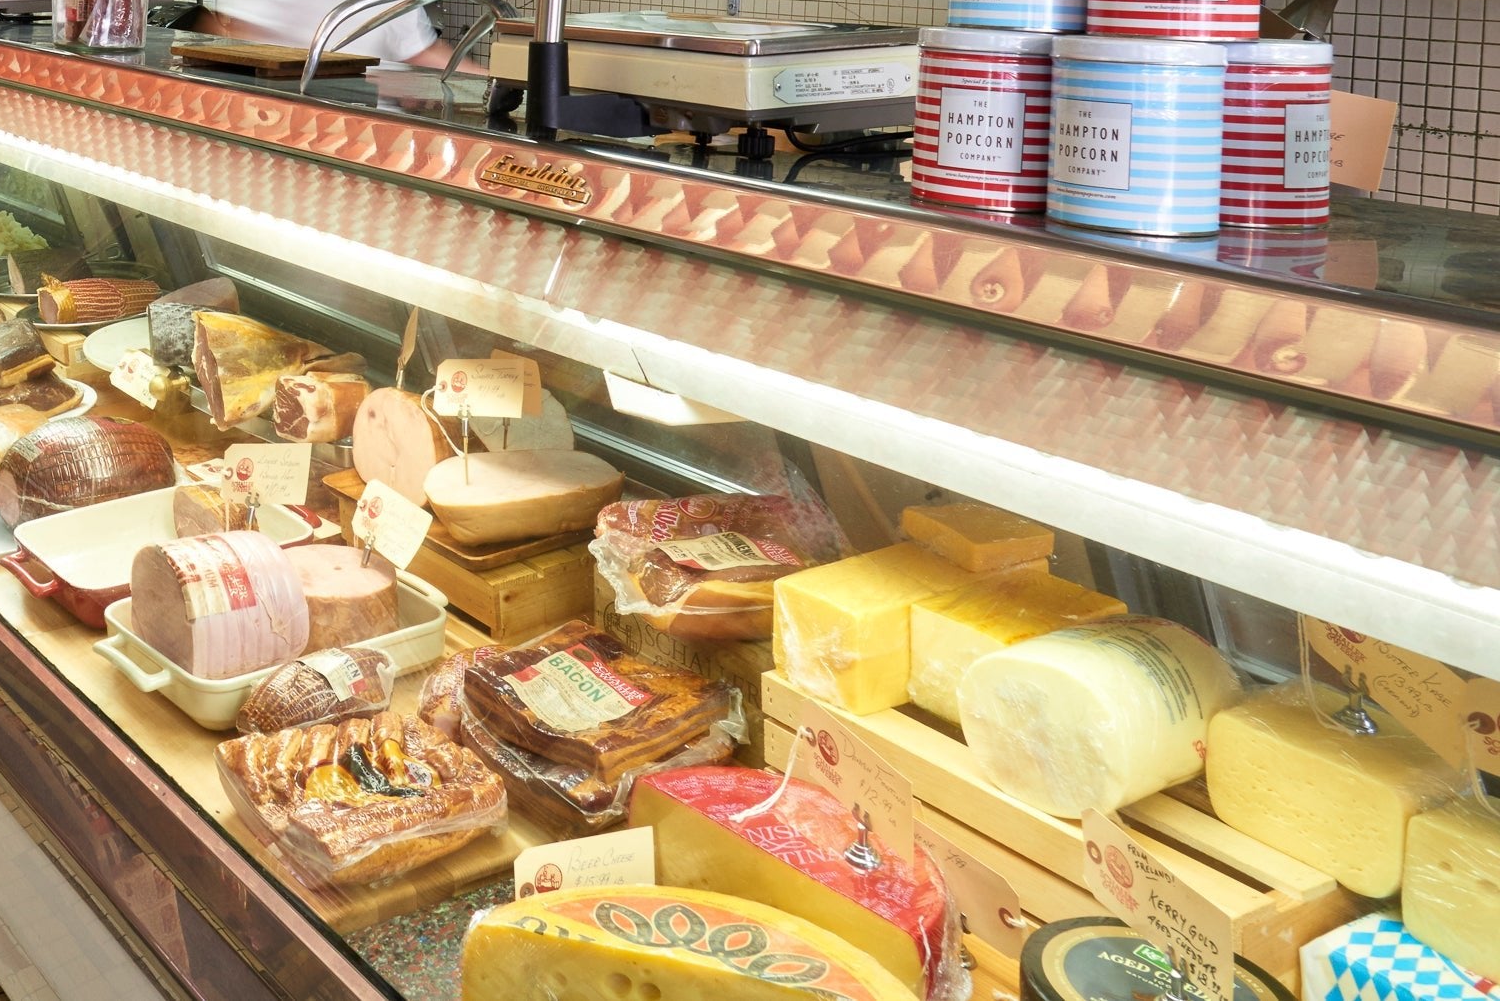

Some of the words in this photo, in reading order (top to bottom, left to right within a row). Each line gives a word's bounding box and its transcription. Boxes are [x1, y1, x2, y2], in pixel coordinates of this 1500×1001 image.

[973, 100, 988, 108] THE
[948, 112, 1014, 129] HAMPTON
[1078, 110, 1092, 119] THE
[947, 132, 1013, 149] POPCORN
[1060, 122, 1119, 141] HAMPTON
[1059, 144, 1118, 163] POPCORN
[548, 656, 607, 703] BACON
[592, 661, 645, 700] SCHALLER
[1127, 843, 1149, 864] FROM
[1148, 889, 1188, 928] KERRY
[1188, 925, 1220, 956] GOLD
[1098, 950, 1151, 974] AGED
[1175, 935, 1218, 980] CHEDDAR
